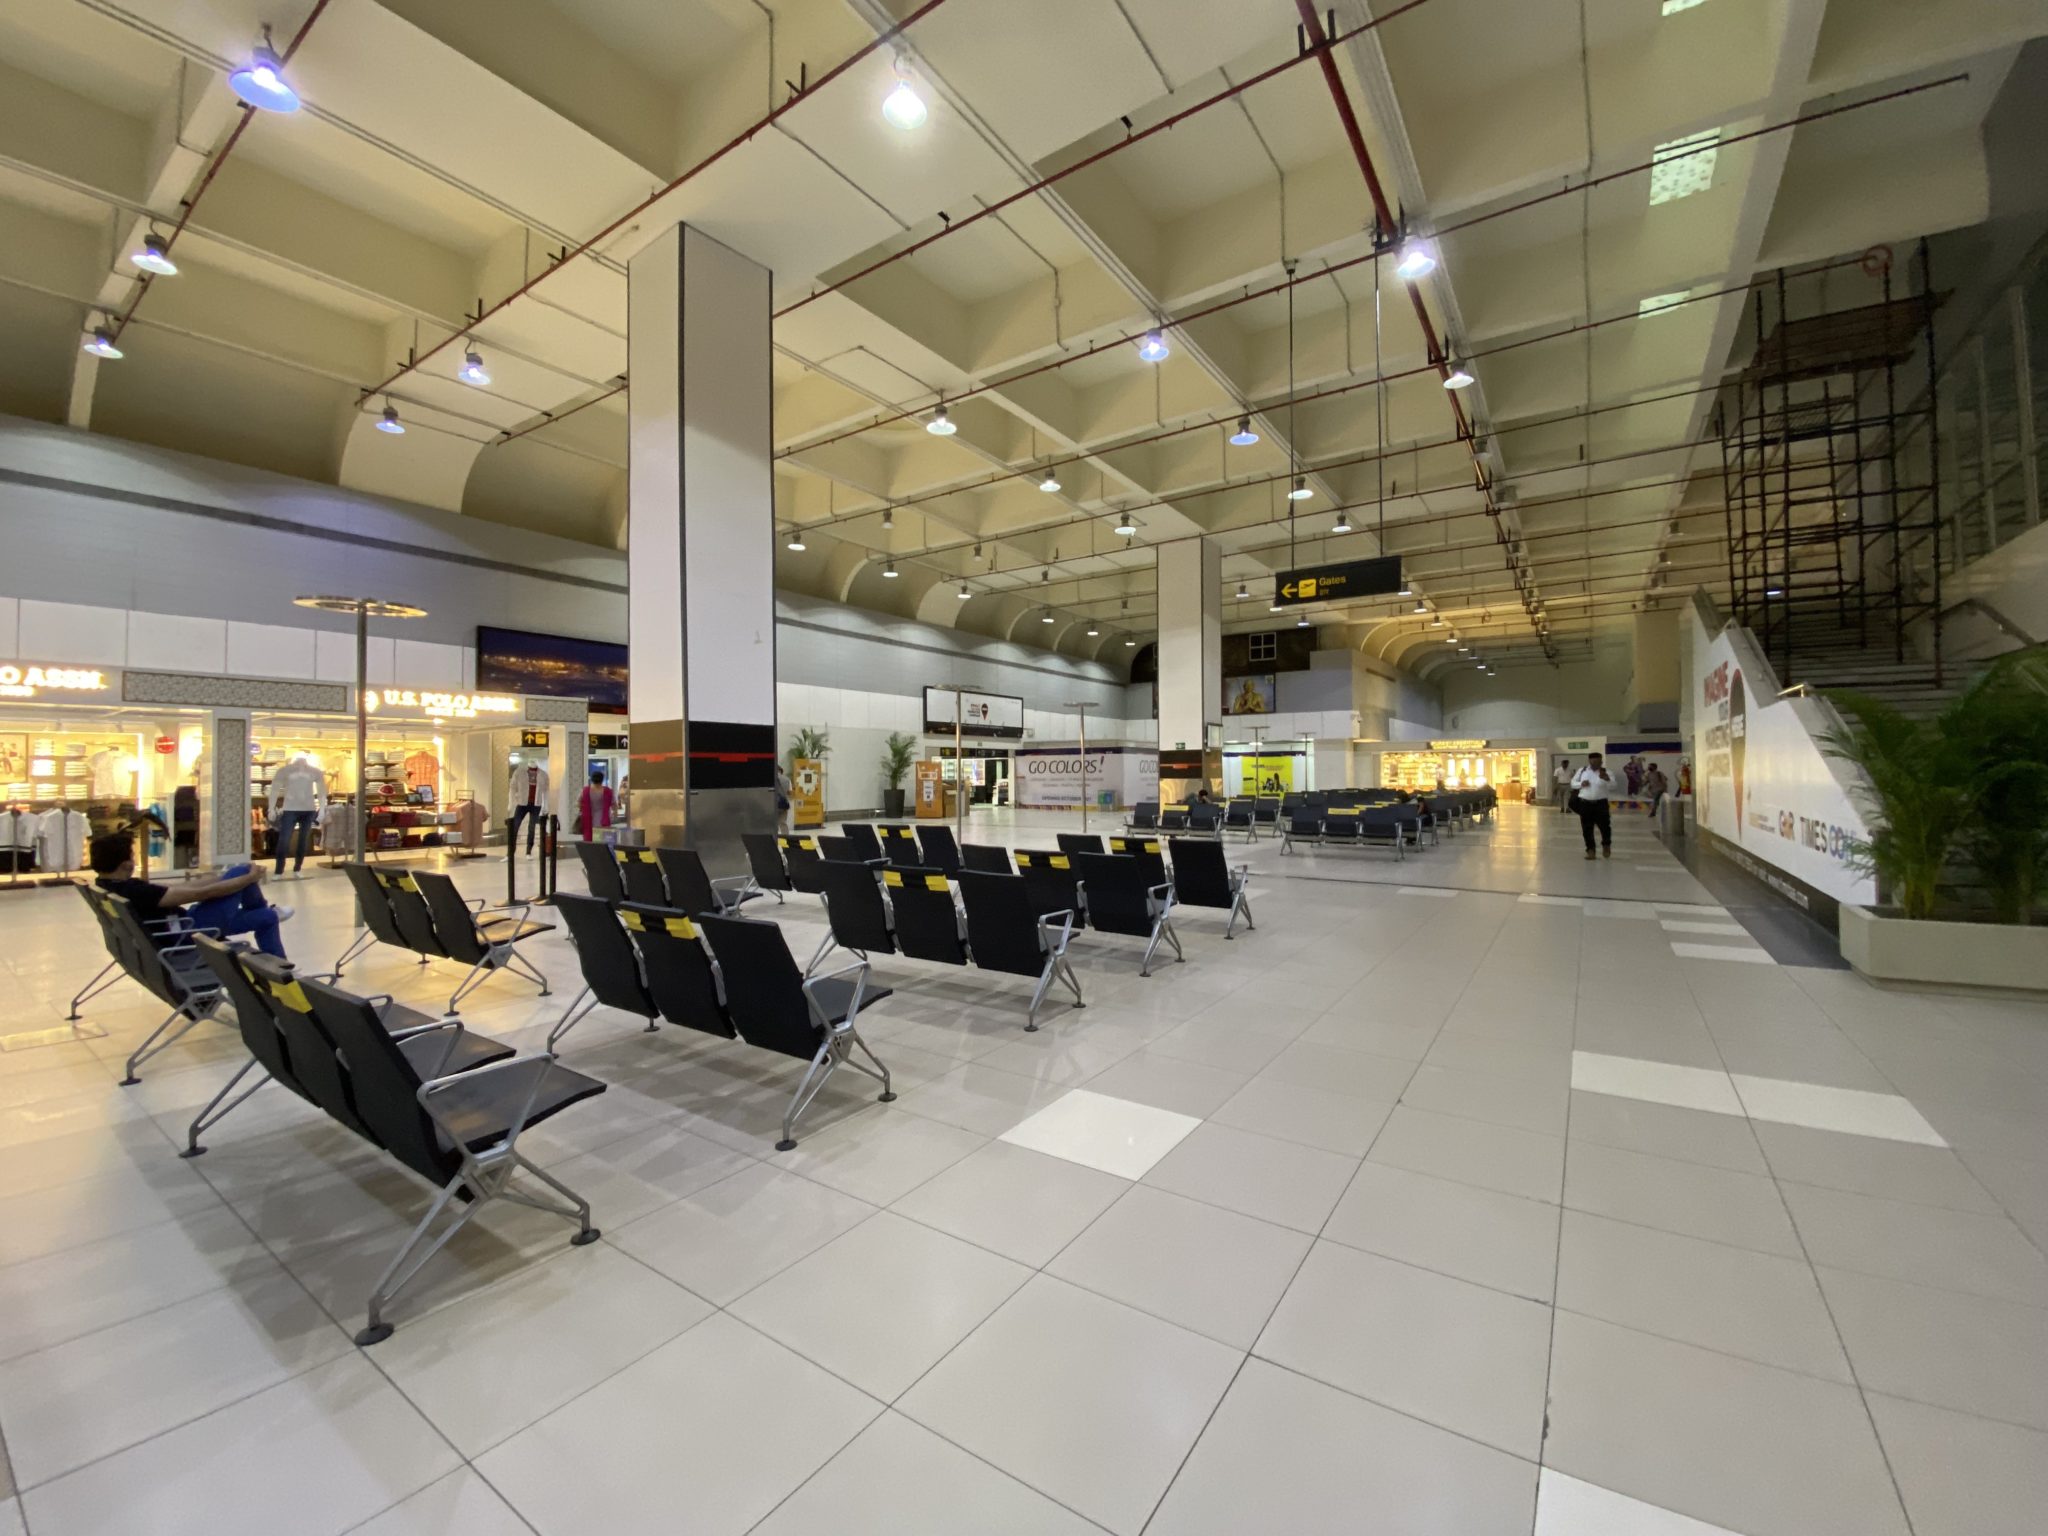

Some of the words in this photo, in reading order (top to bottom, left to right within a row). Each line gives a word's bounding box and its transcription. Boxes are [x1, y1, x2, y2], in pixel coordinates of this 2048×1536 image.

[1319, 576, 1347, 586] Gates
[1028, 760, 1047, 774] GO
[1800, 816, 1828, 853] TIMES
